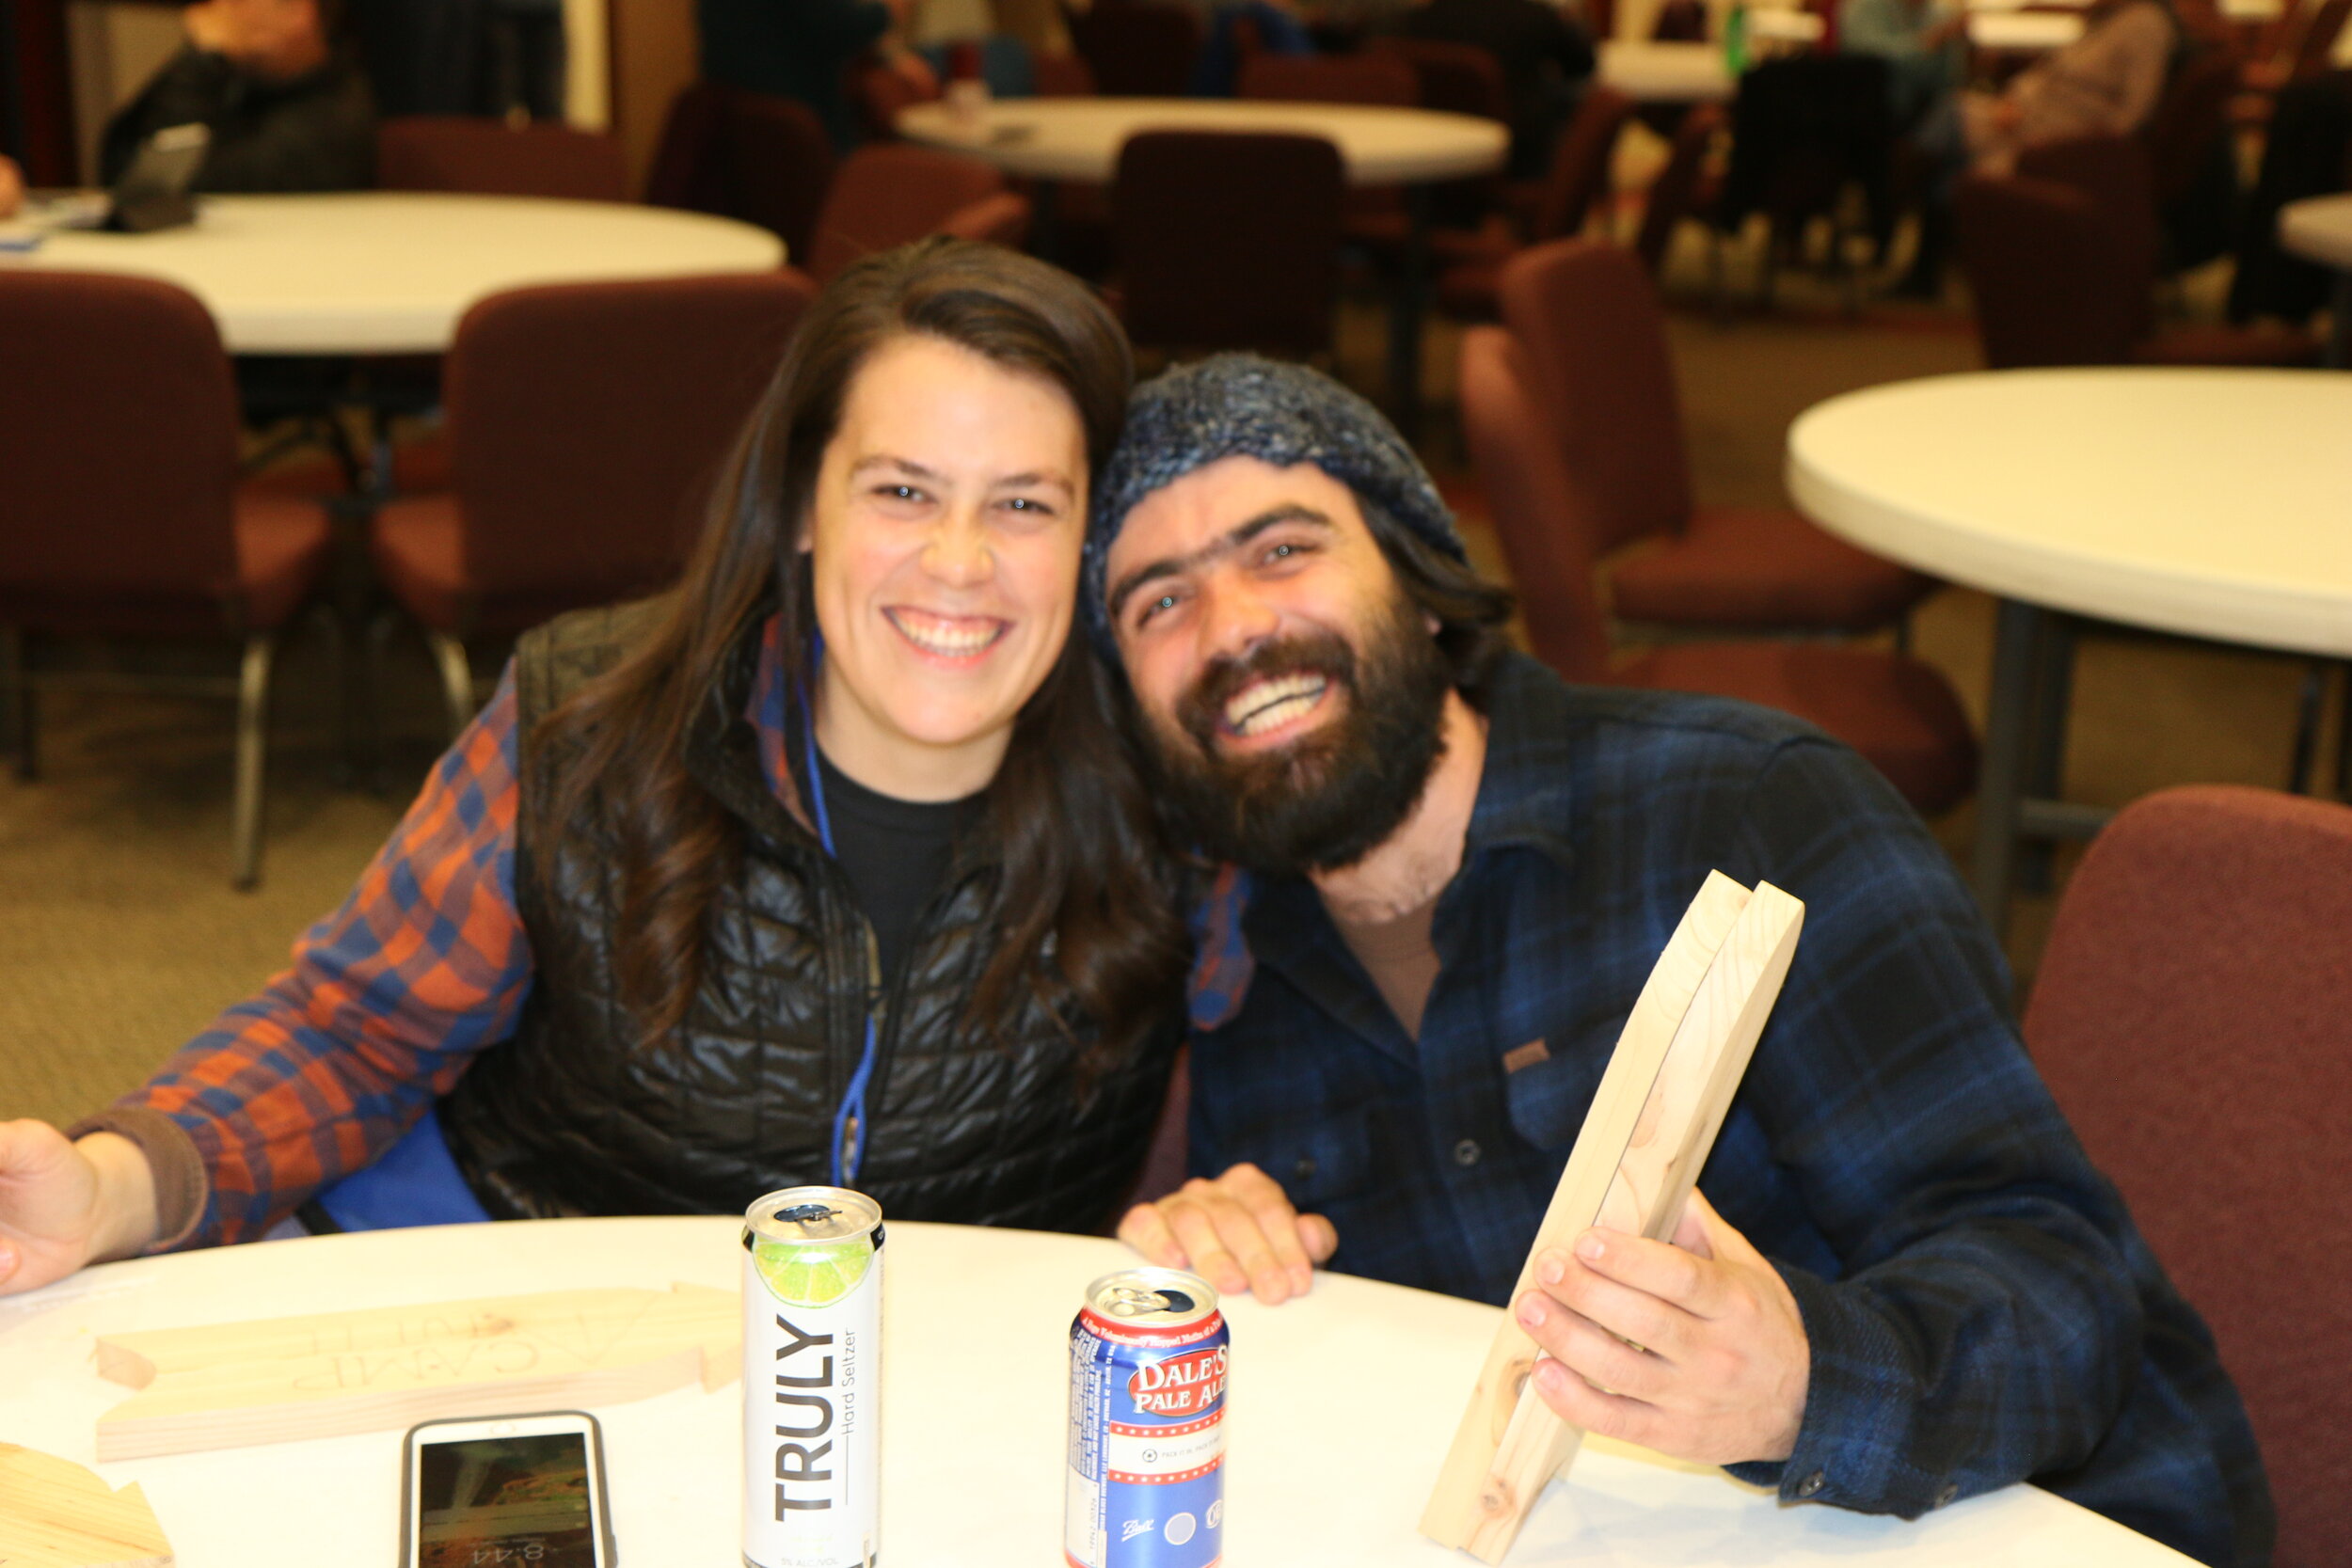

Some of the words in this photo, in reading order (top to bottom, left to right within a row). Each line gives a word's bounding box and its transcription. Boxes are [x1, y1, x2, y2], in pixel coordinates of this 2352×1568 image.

[292, 1341, 541, 1392] CAMP
[842, 1329, 856, 1384] Seltzer
[1136, 1343, 1229, 1391] DALE'S
[774, 1313, 834, 1522] TRULY
[842, 1392, 856, 1434] Hard
[1133, 1391, 1192, 1414] PALE
[1121, 1518, 1155, 1541] Ball
[472, 1543, 545, 1565] 8:44
